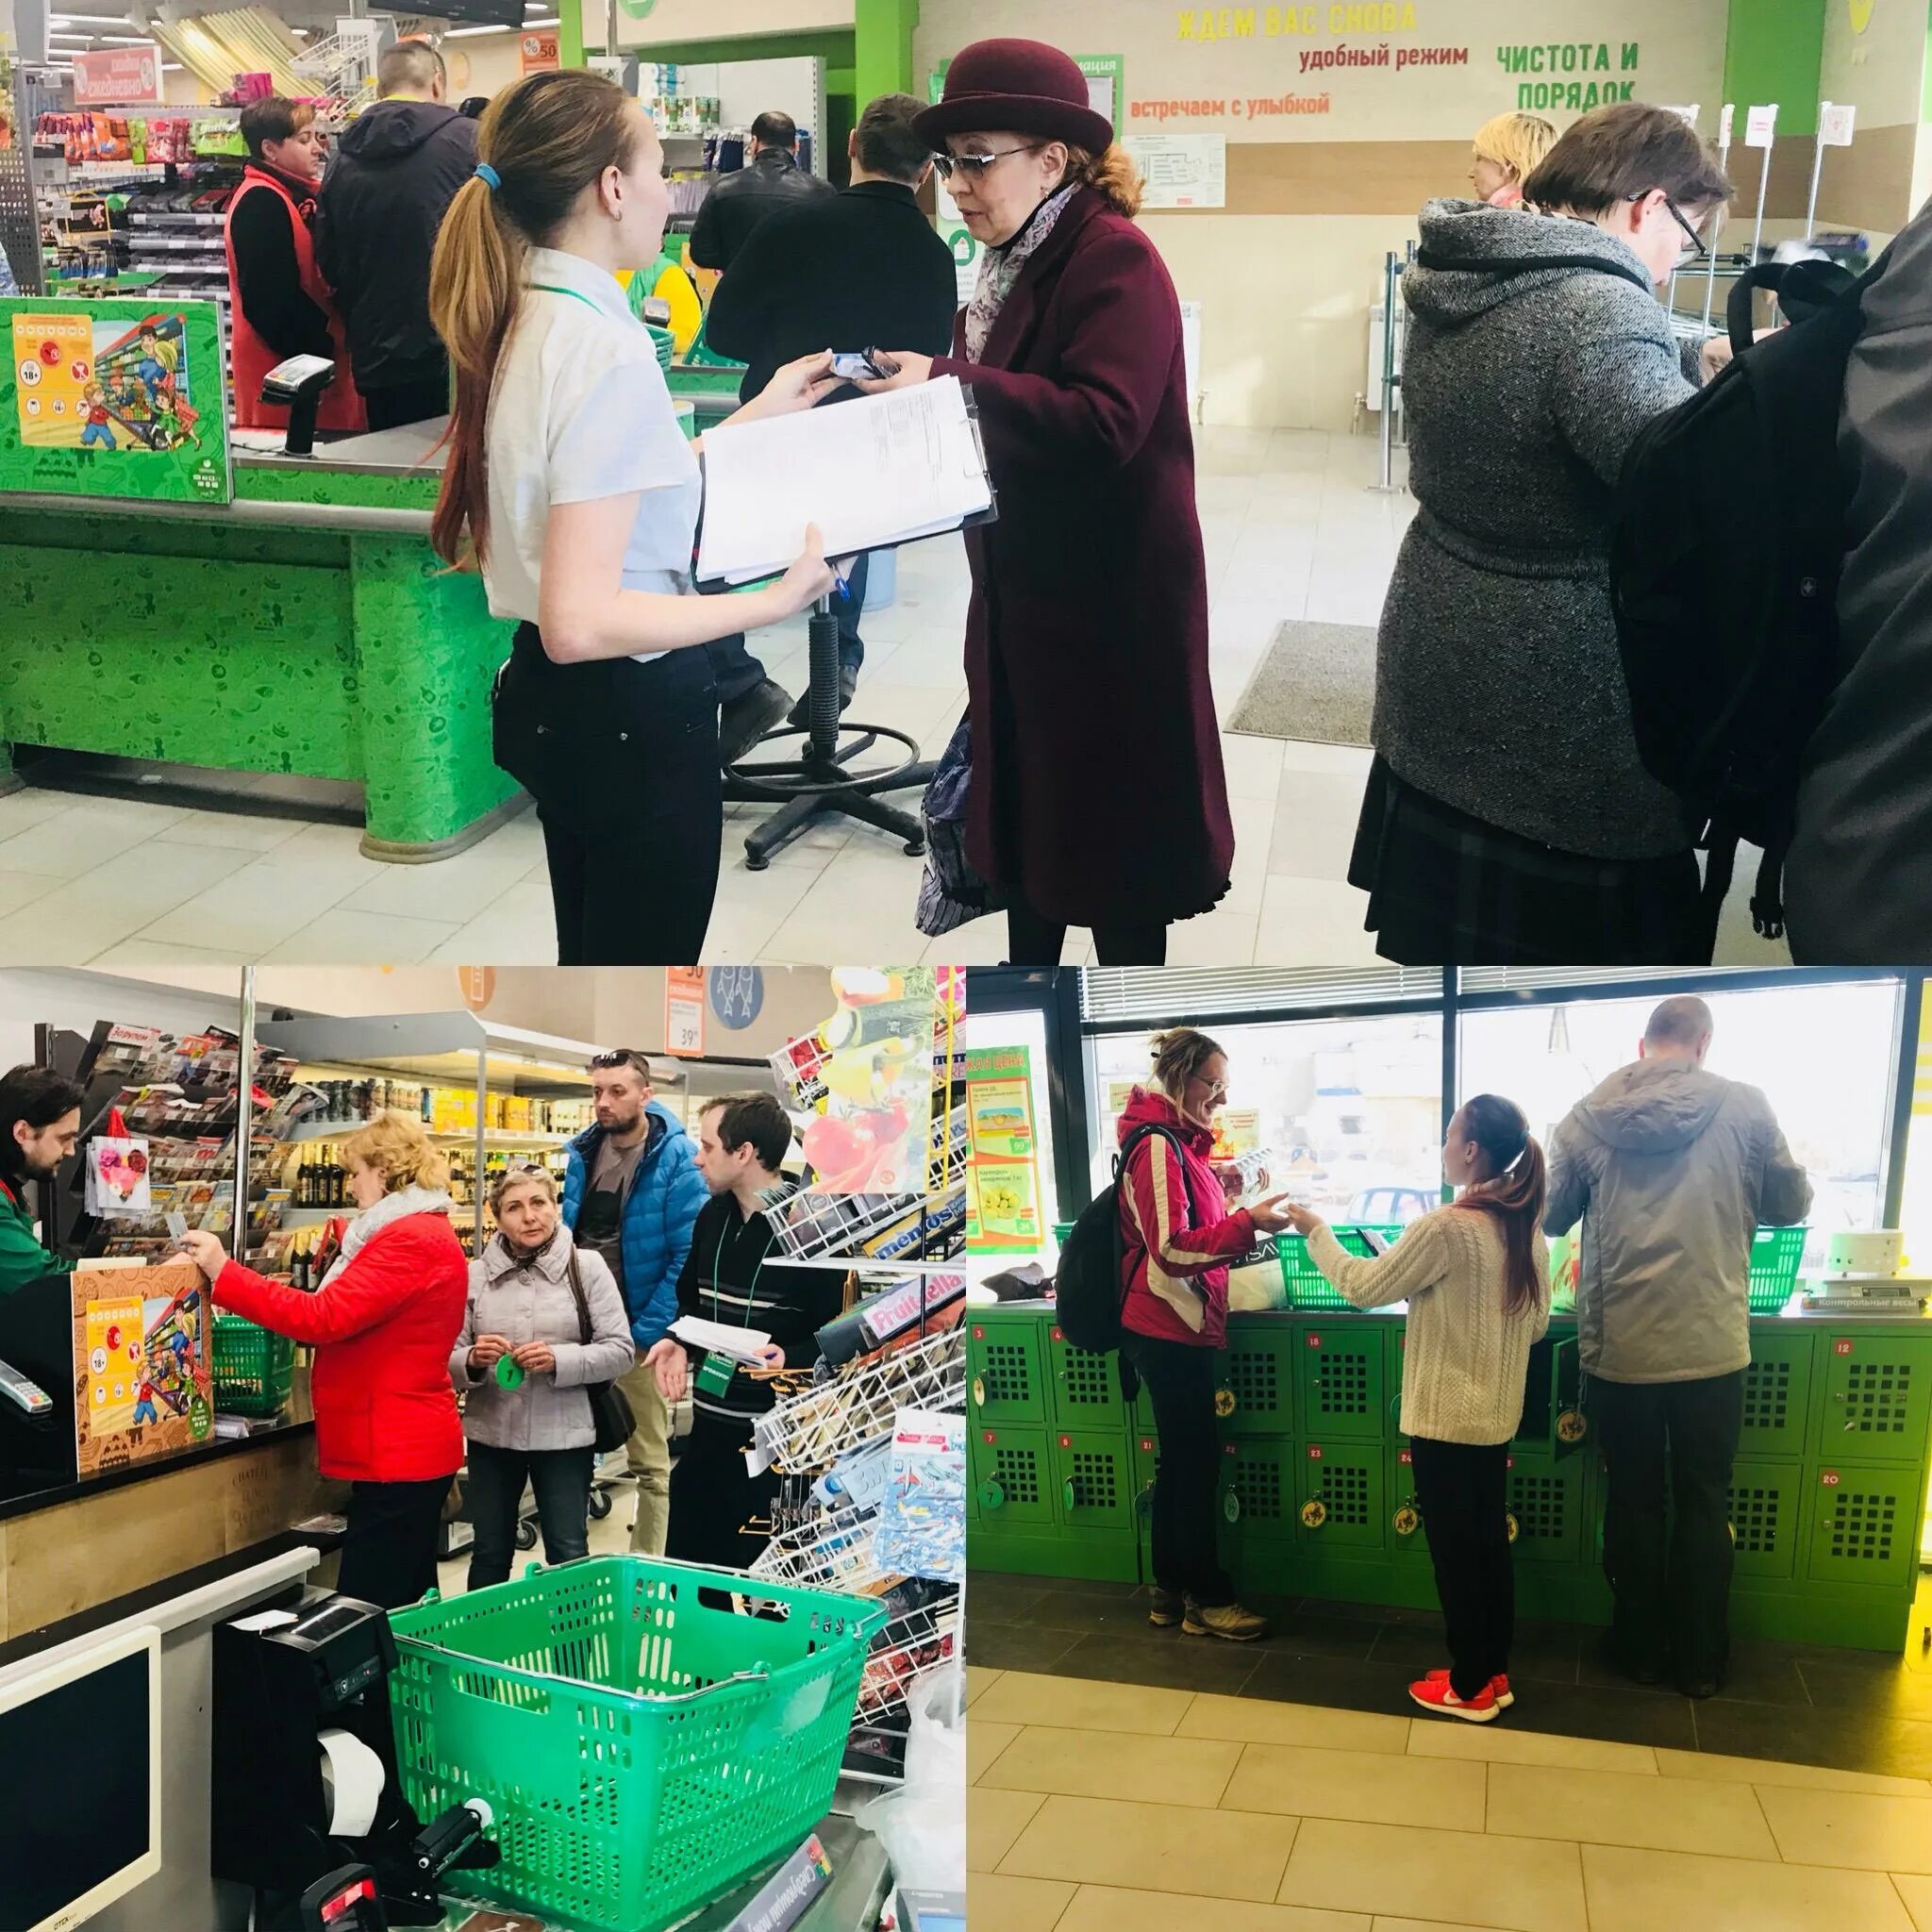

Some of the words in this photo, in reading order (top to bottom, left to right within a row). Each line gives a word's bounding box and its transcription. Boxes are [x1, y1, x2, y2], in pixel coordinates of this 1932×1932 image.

[1176, 8, 1257, 44] ЖДЕМ
[1264, 6, 1319, 38] ВАС
[1327, 2, 1418, 35] СНОВА
[541, 44, 558, 58] 50
[1496, 43, 1610, 73] ЧИСТОТА
[1620, 42, 1639, 71] И
[1299, 43, 1391, 74] удобный
[1395, 47, 1469, 72] режим
[1517, 80, 1637, 113] ПОРЯДОК
[1130, 96, 1225, 123] встречаем
[1230, 97, 1241, 115] с
[1246, 92, 1331, 120] улыбкой
[871, 1274, 963, 1334] Fruitella
[1818, 1297, 1890, 1308] Контрольные
[1892, 1299, 1917, 1307] весы
[1309, 1337, 1319, 1346] 18
[1838, 1343, 1850, 1353] 12
[506, 1369, 514, 1383] 1
[1143, 1441, 1152, 1450] 21
[1310, 1449, 1322, 1457] 23
[1823, 1474, 1839, 1485] 20
[987, 1492, 994, 1504] 7
